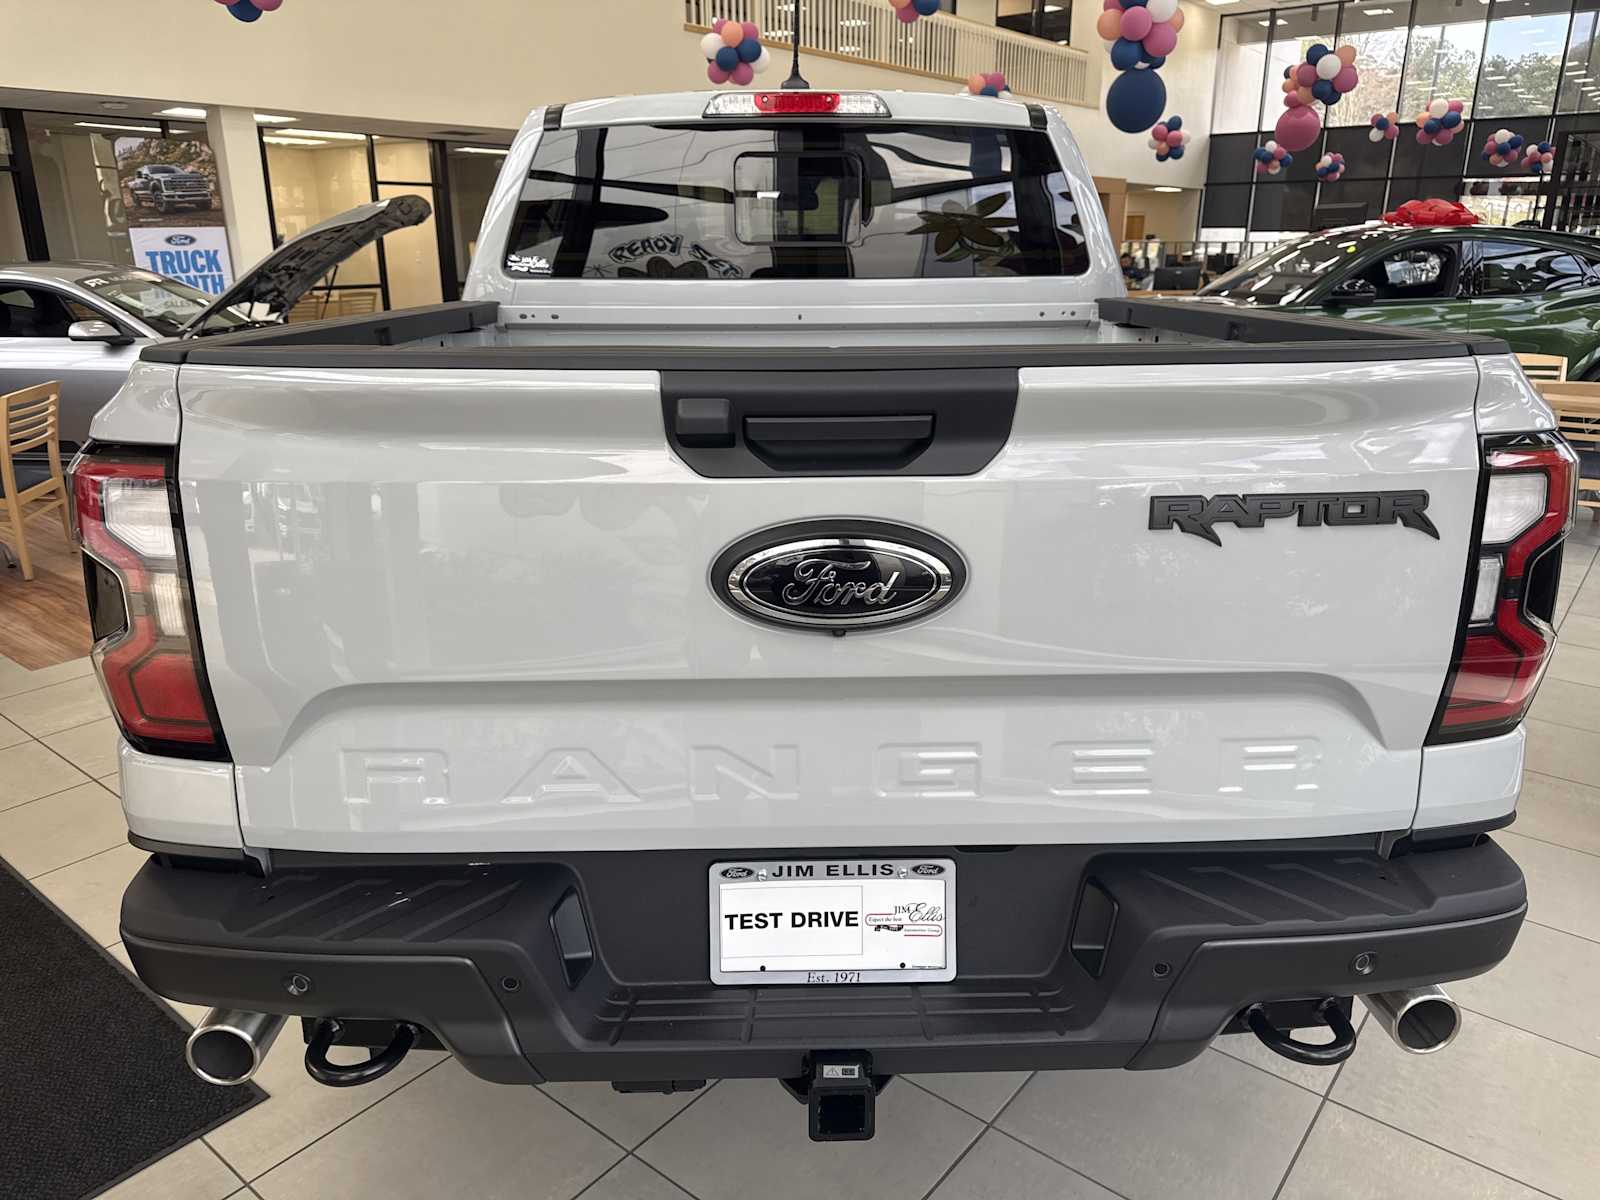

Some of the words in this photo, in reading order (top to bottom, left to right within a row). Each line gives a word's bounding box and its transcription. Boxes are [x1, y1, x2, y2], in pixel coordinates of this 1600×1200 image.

[609, 233, 684, 263] READY
[145, 249, 223, 274] TRUCK
[1148, 489, 1440, 547] RAPTOR
[782, 558, 900, 606] Ford
[339, 736, 1323, 804] RANGER
[725, 868, 750, 879] Ford
[772, 865, 814, 877] JIM
[826, 864, 894, 877] ELLIS
[916, 864, 940, 875] Ford
[724, 912, 783, 931] TEST
[791, 911, 859, 928] DRIVE
[907, 902, 943, 923] Ellis
[807, 972, 830, 983] Est.
[834, 972, 861, 983] 1971
